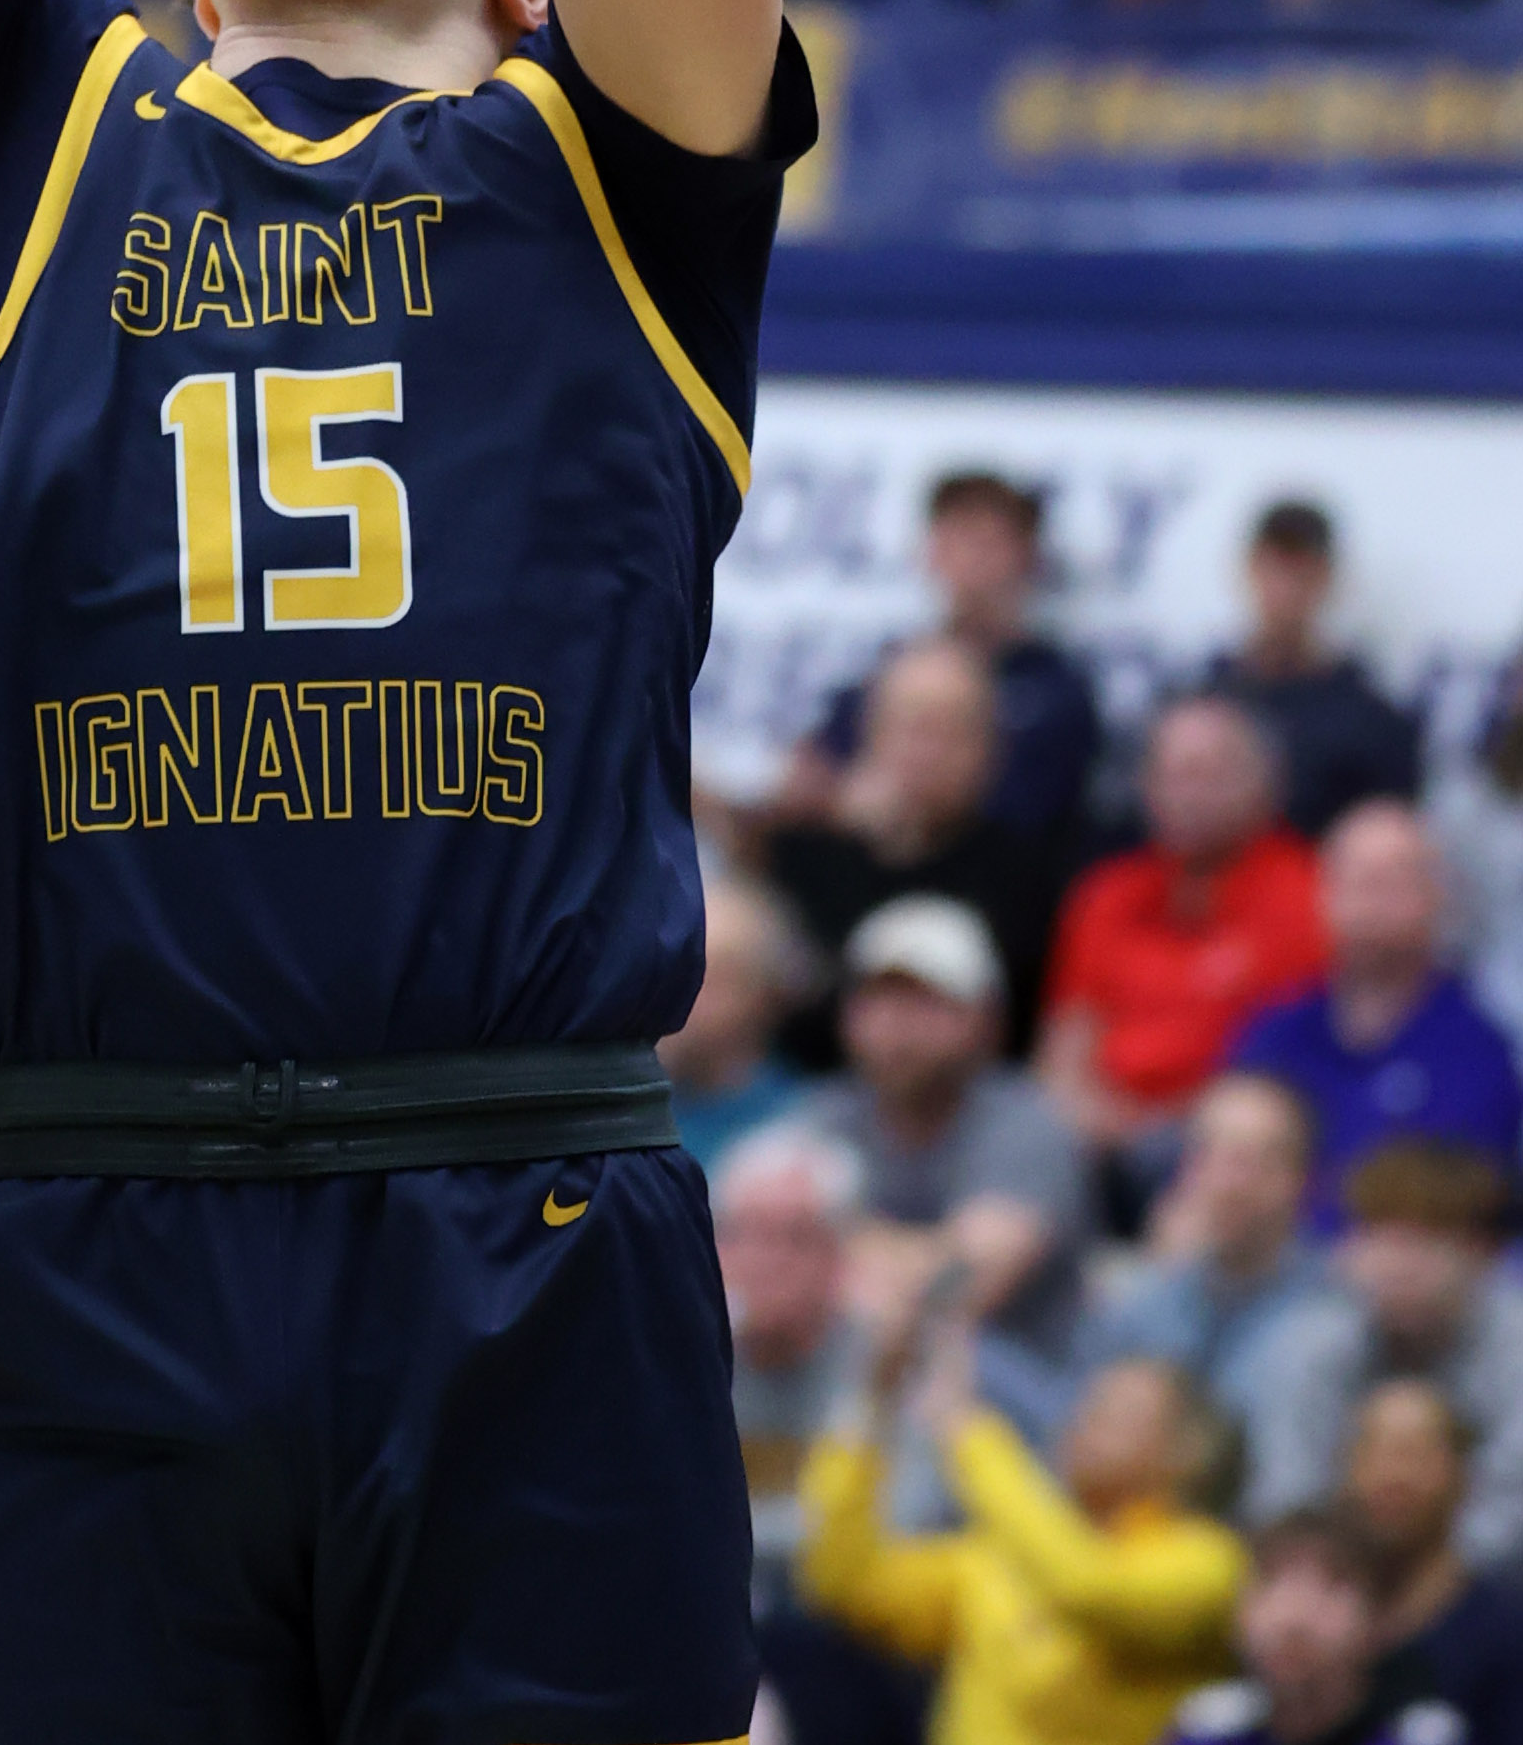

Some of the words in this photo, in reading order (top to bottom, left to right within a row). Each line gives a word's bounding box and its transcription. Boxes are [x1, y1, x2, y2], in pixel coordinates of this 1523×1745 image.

[112, 195, 442, 337] SAINT
[161, 362, 413, 634] 15
[34, 680, 545, 842] IGNATIUS
